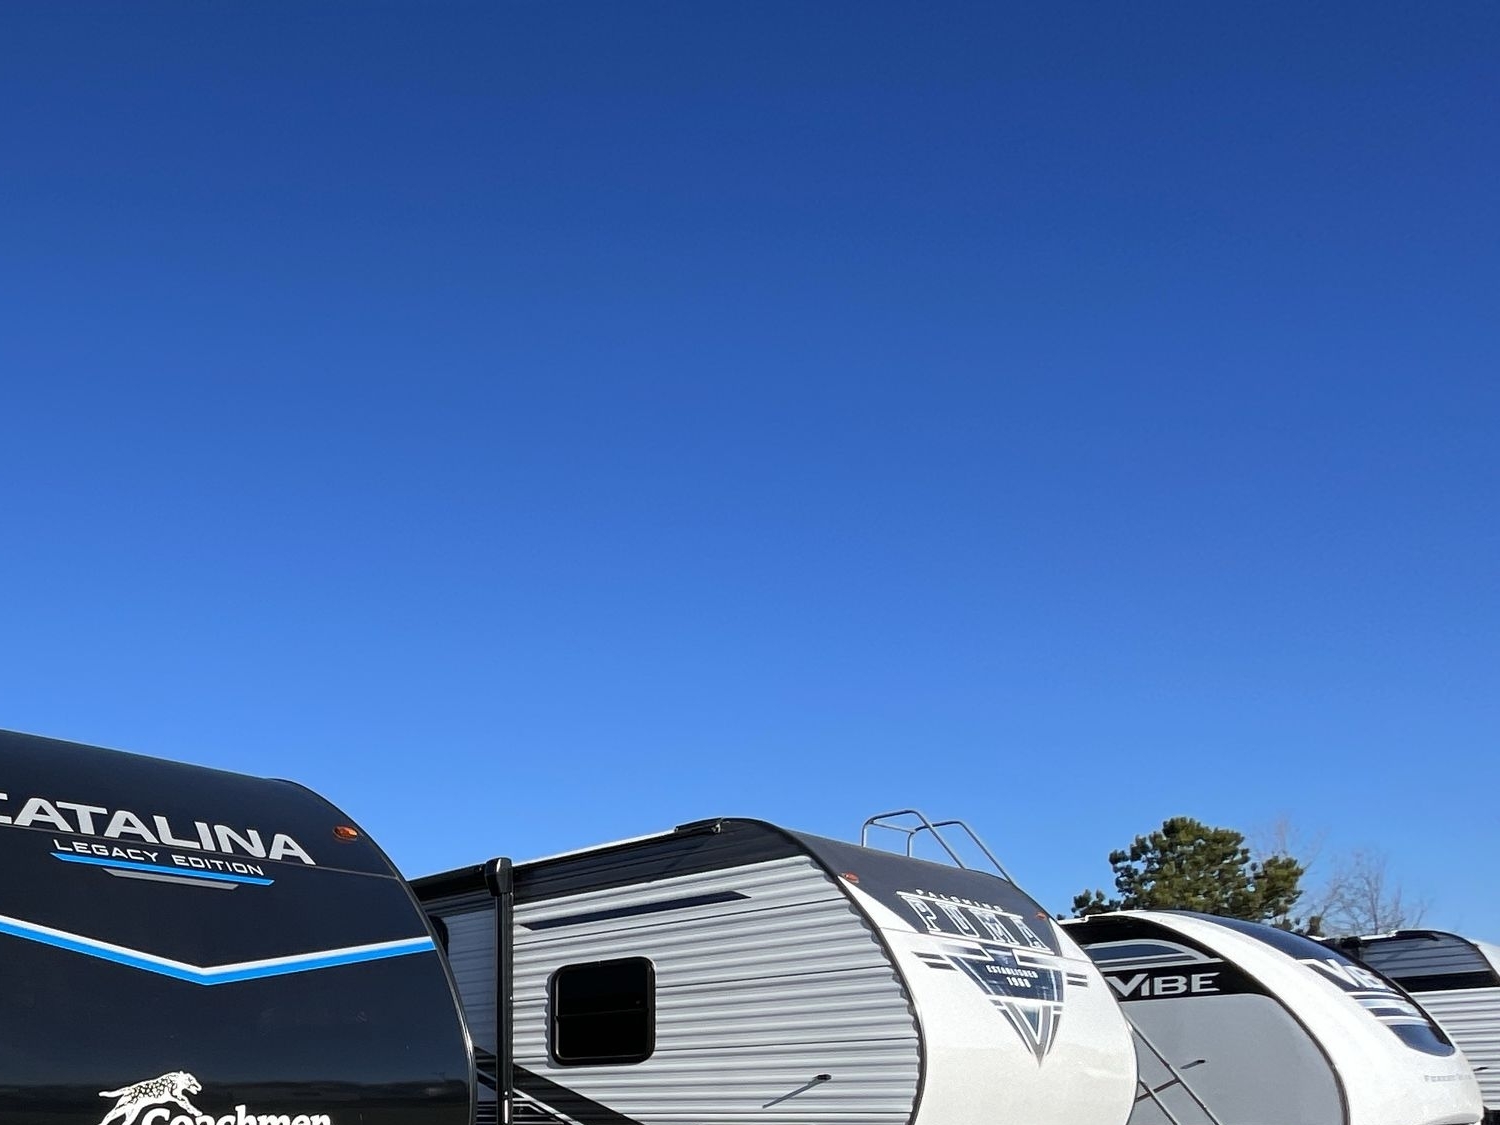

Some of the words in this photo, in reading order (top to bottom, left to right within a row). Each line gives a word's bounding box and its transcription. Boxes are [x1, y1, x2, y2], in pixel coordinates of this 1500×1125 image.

[53, 839, 158, 863] LEGACY
[172, 854, 265, 876] EDITION
[900, 895, 1052, 951] PUMA
[1104, 971, 1221, 998] VIBE
